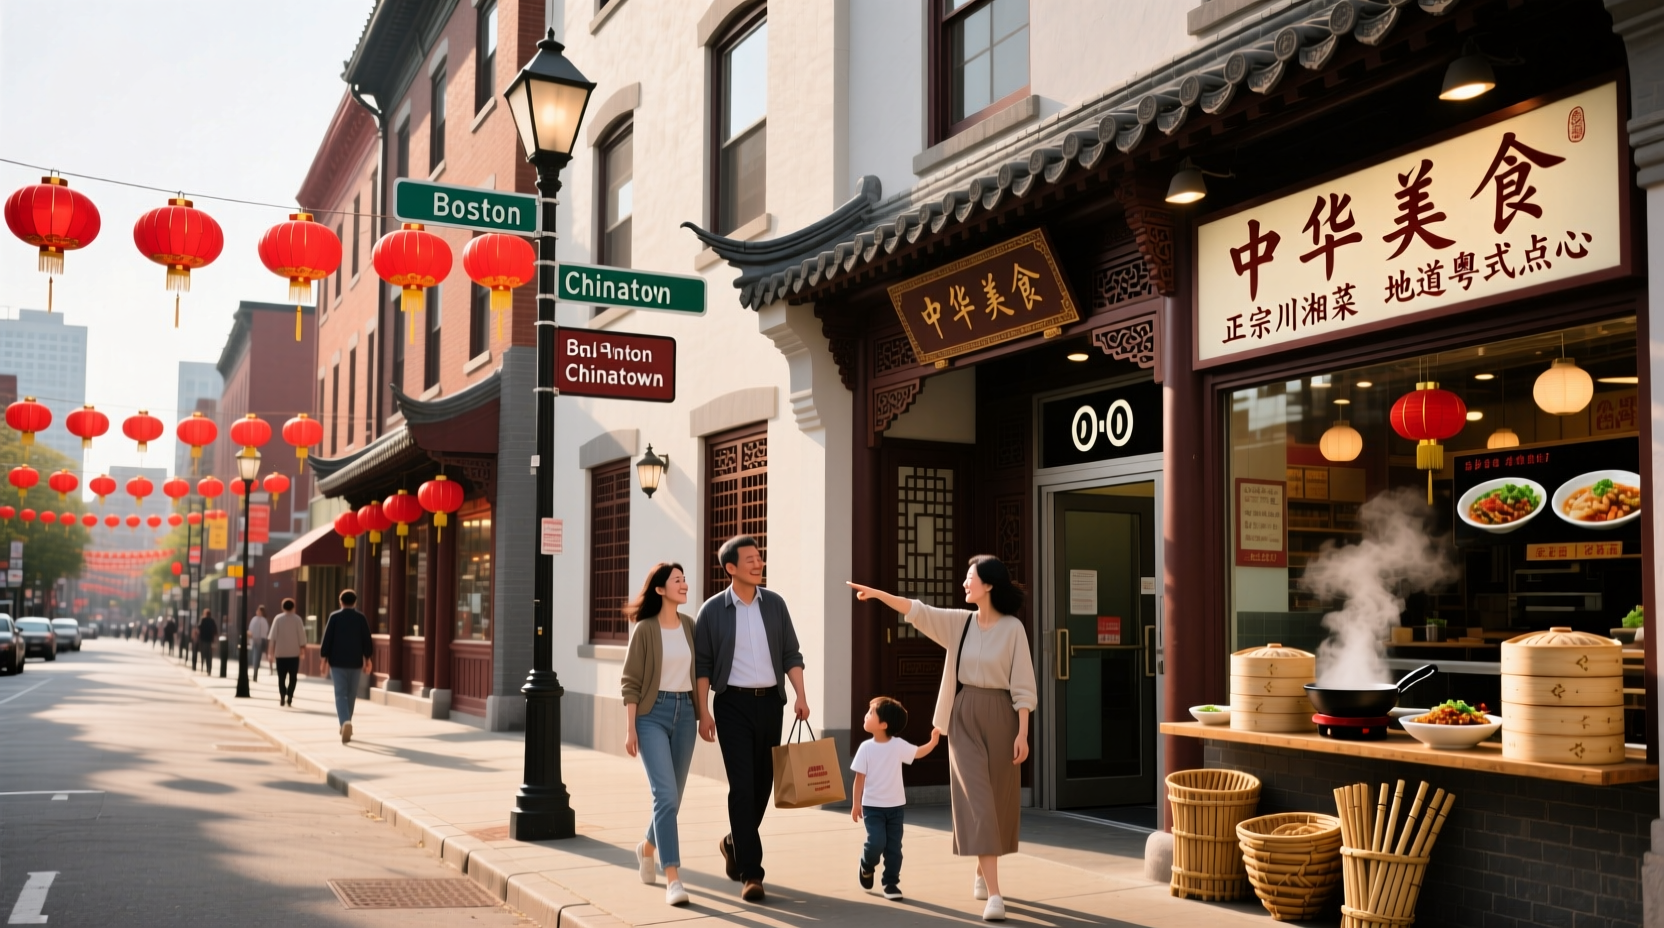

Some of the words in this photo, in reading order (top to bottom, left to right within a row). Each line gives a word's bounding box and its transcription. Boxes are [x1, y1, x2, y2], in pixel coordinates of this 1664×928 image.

[432, 191, 521, 226] Boston
[1229, 132, 1567, 302] 中华美食
[920, 262, 1043, 340] 中华美食
[1222, 282, 1359, 344] 正宗川湘菜
[1384, 231, 1593, 304] 地道粤式点心
[565, 363, 664, 388] Chinatown
